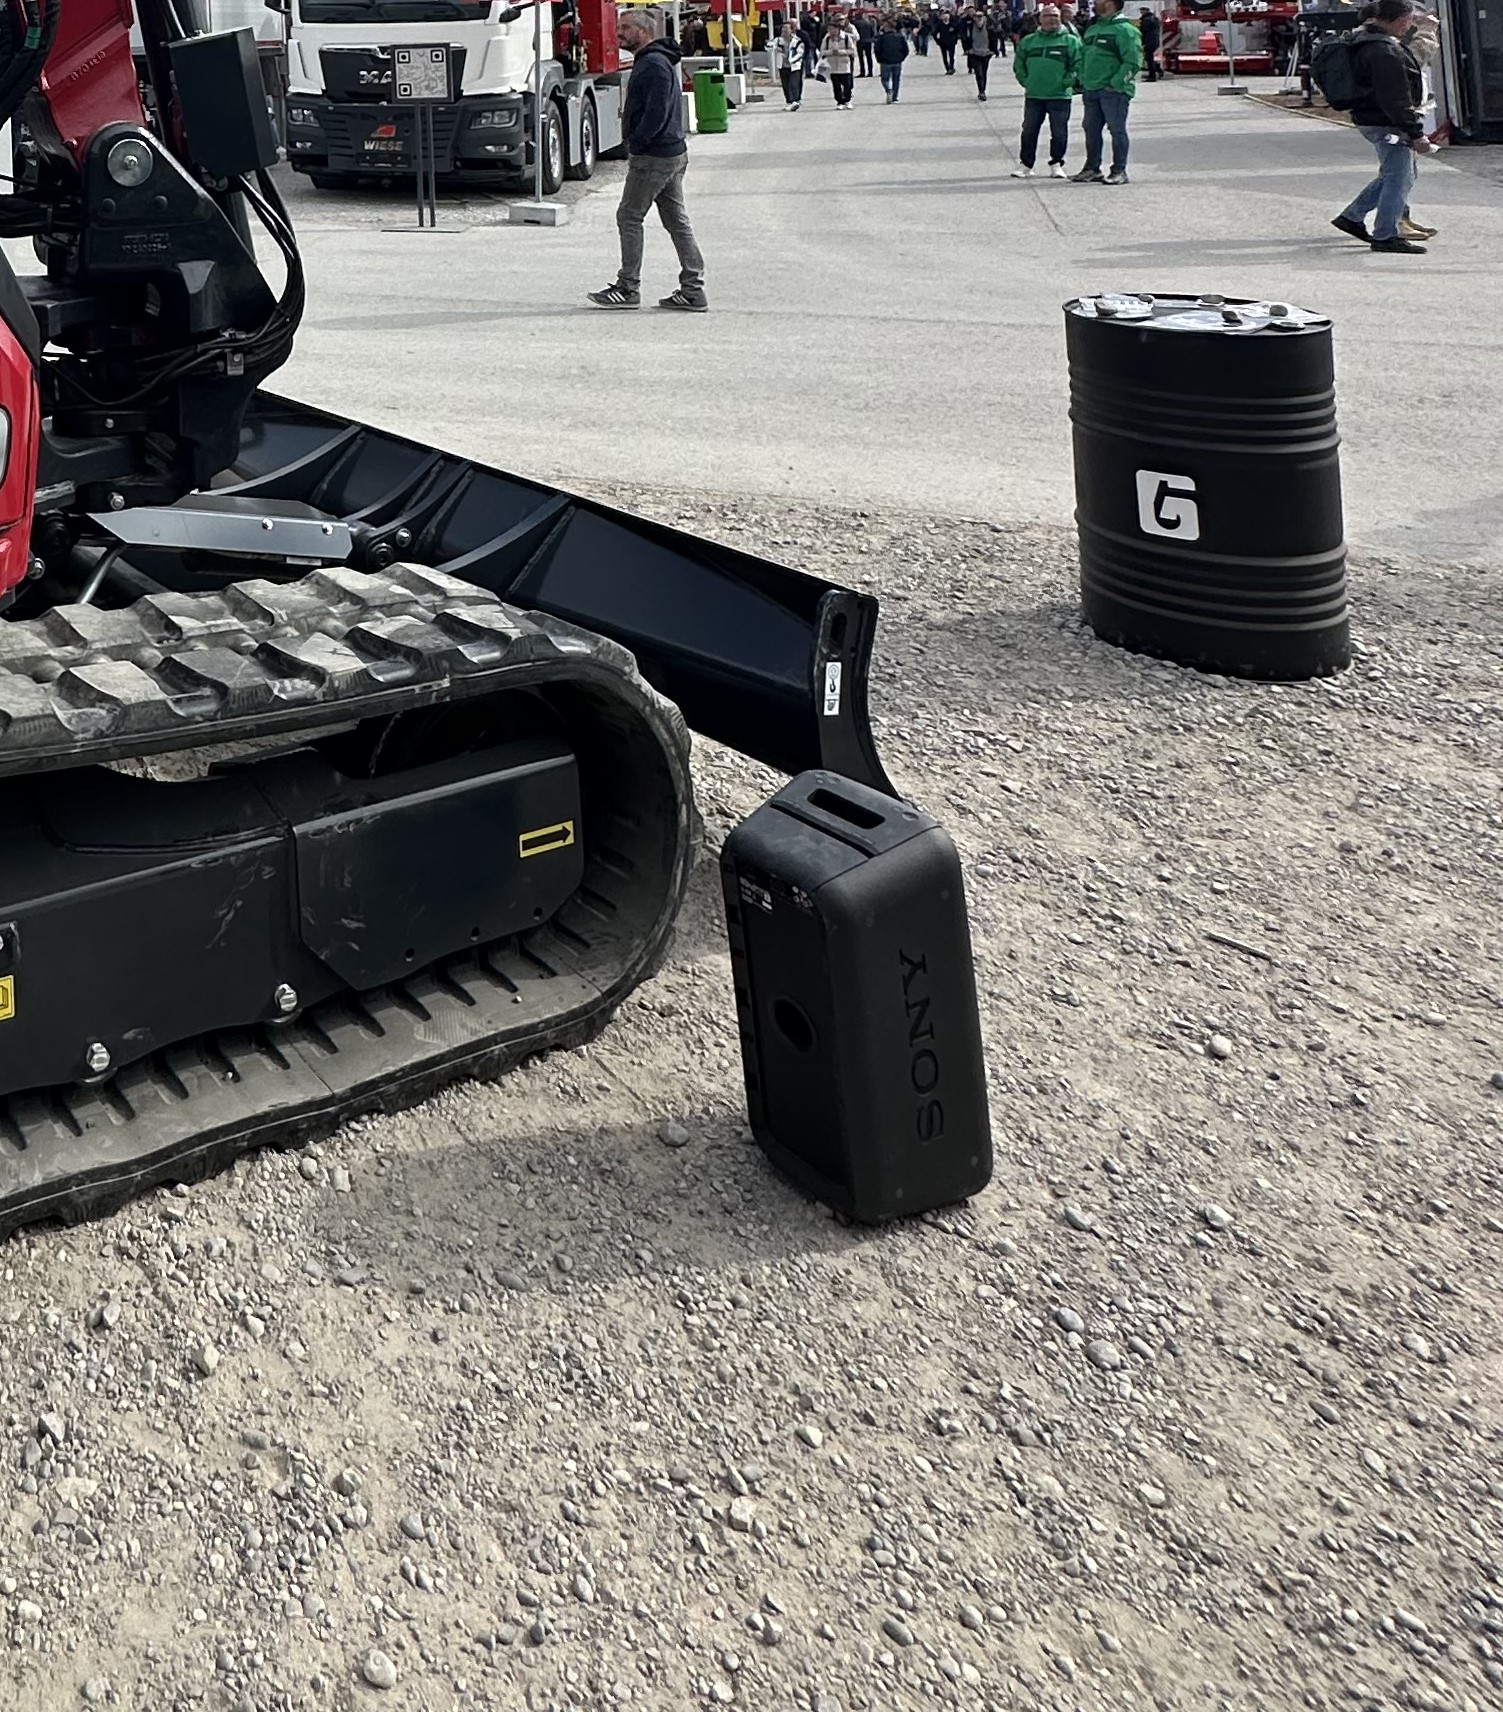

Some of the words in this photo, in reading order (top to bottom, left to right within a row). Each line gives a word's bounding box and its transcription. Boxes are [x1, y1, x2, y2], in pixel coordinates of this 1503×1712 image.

[359, 70, 392, 84] MA
[363, 139, 404, 151] WIESE
[899, 948, 946, 1146] SONY
